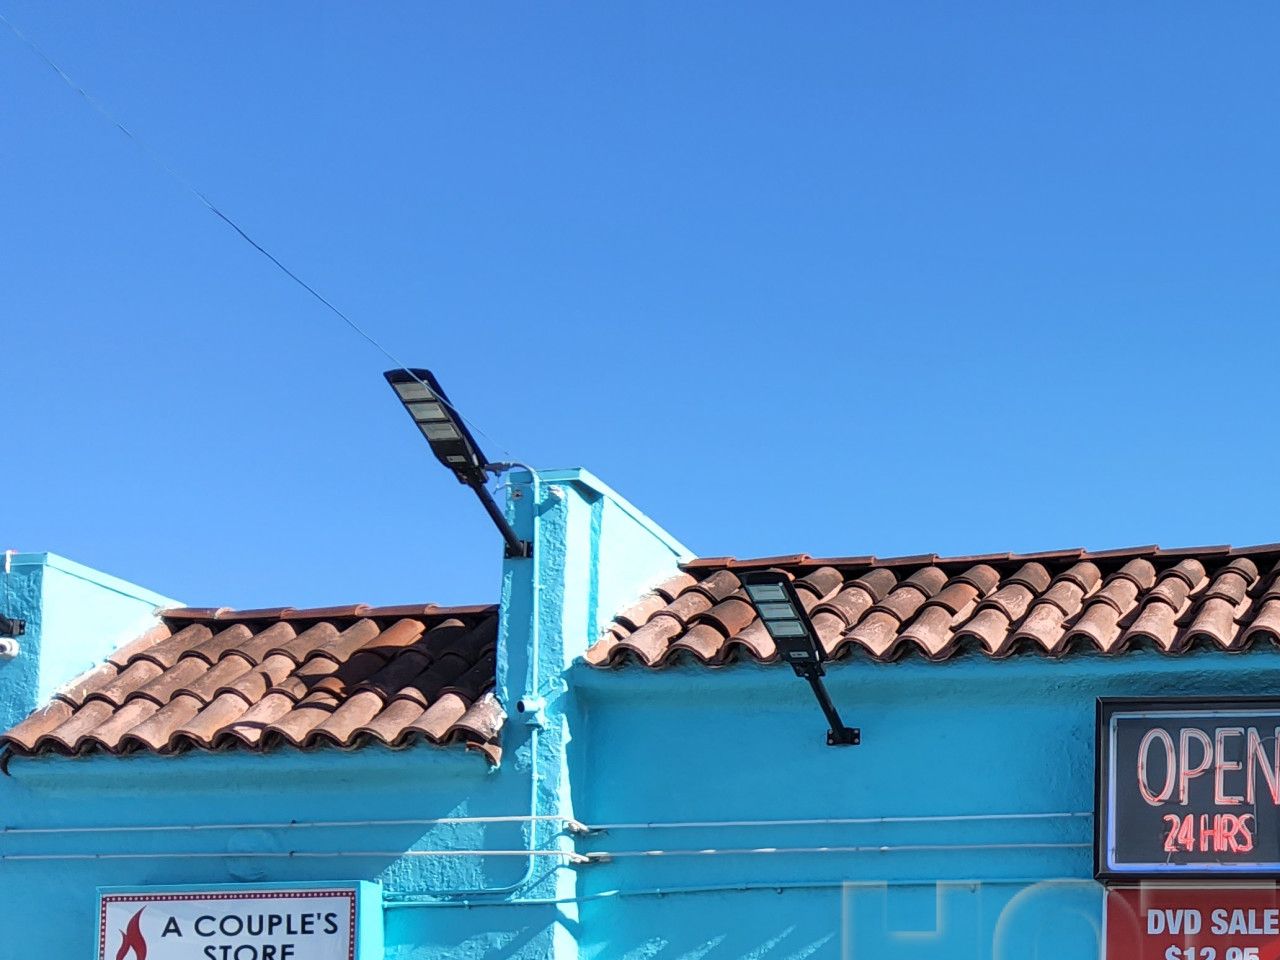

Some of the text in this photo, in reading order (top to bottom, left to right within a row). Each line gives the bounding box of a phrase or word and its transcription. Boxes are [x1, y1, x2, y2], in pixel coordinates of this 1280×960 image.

[1163, 812, 1255, 853] 24 HRS
[161, 912, 338, 937] A COUPLE'S
[1147, 909, 1280, 935] DVD SALE
